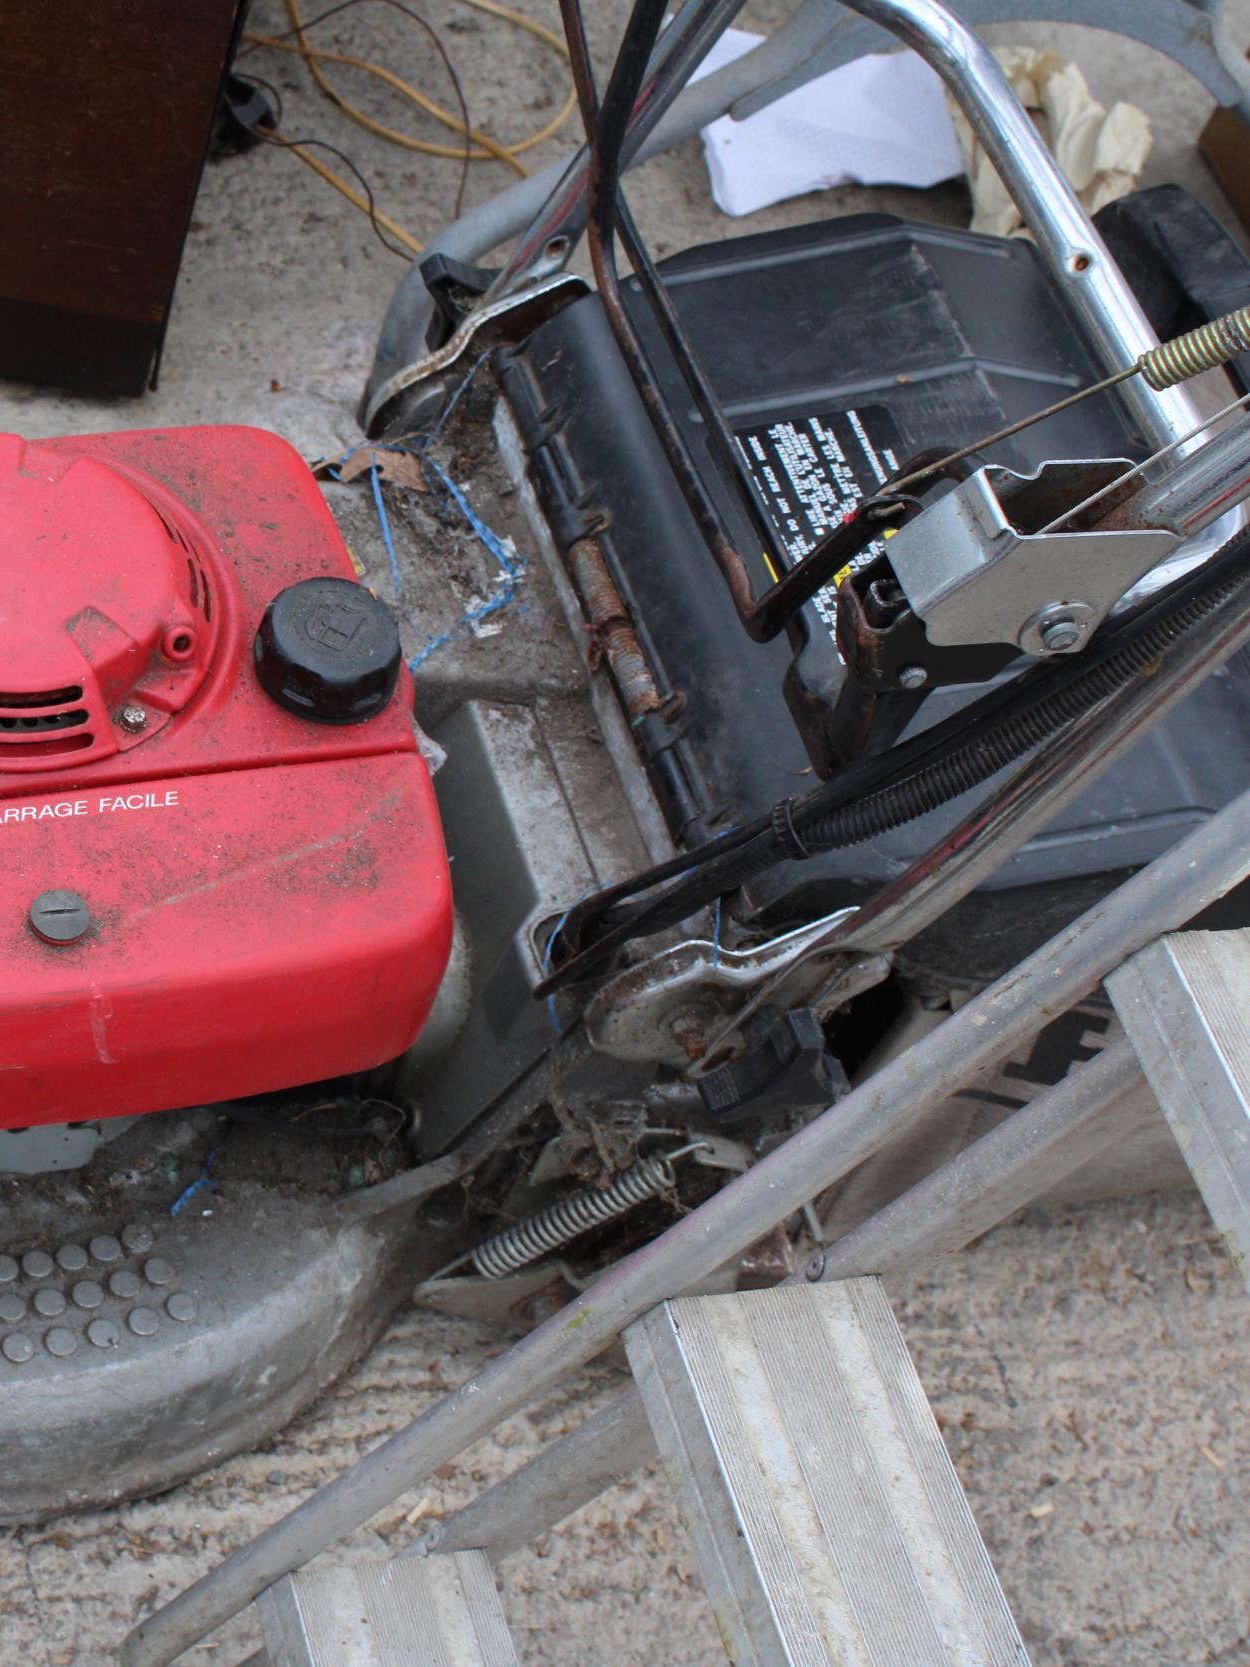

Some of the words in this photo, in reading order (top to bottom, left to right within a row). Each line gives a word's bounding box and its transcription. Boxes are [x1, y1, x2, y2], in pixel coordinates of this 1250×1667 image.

[747, 436, 767, 462] INSIDE
[761, 466, 782, 493] REACH
[776, 497, 792, 514] NOT
[786, 519, 800, 532] DO
[98, 791, 180, 813] FACILE
